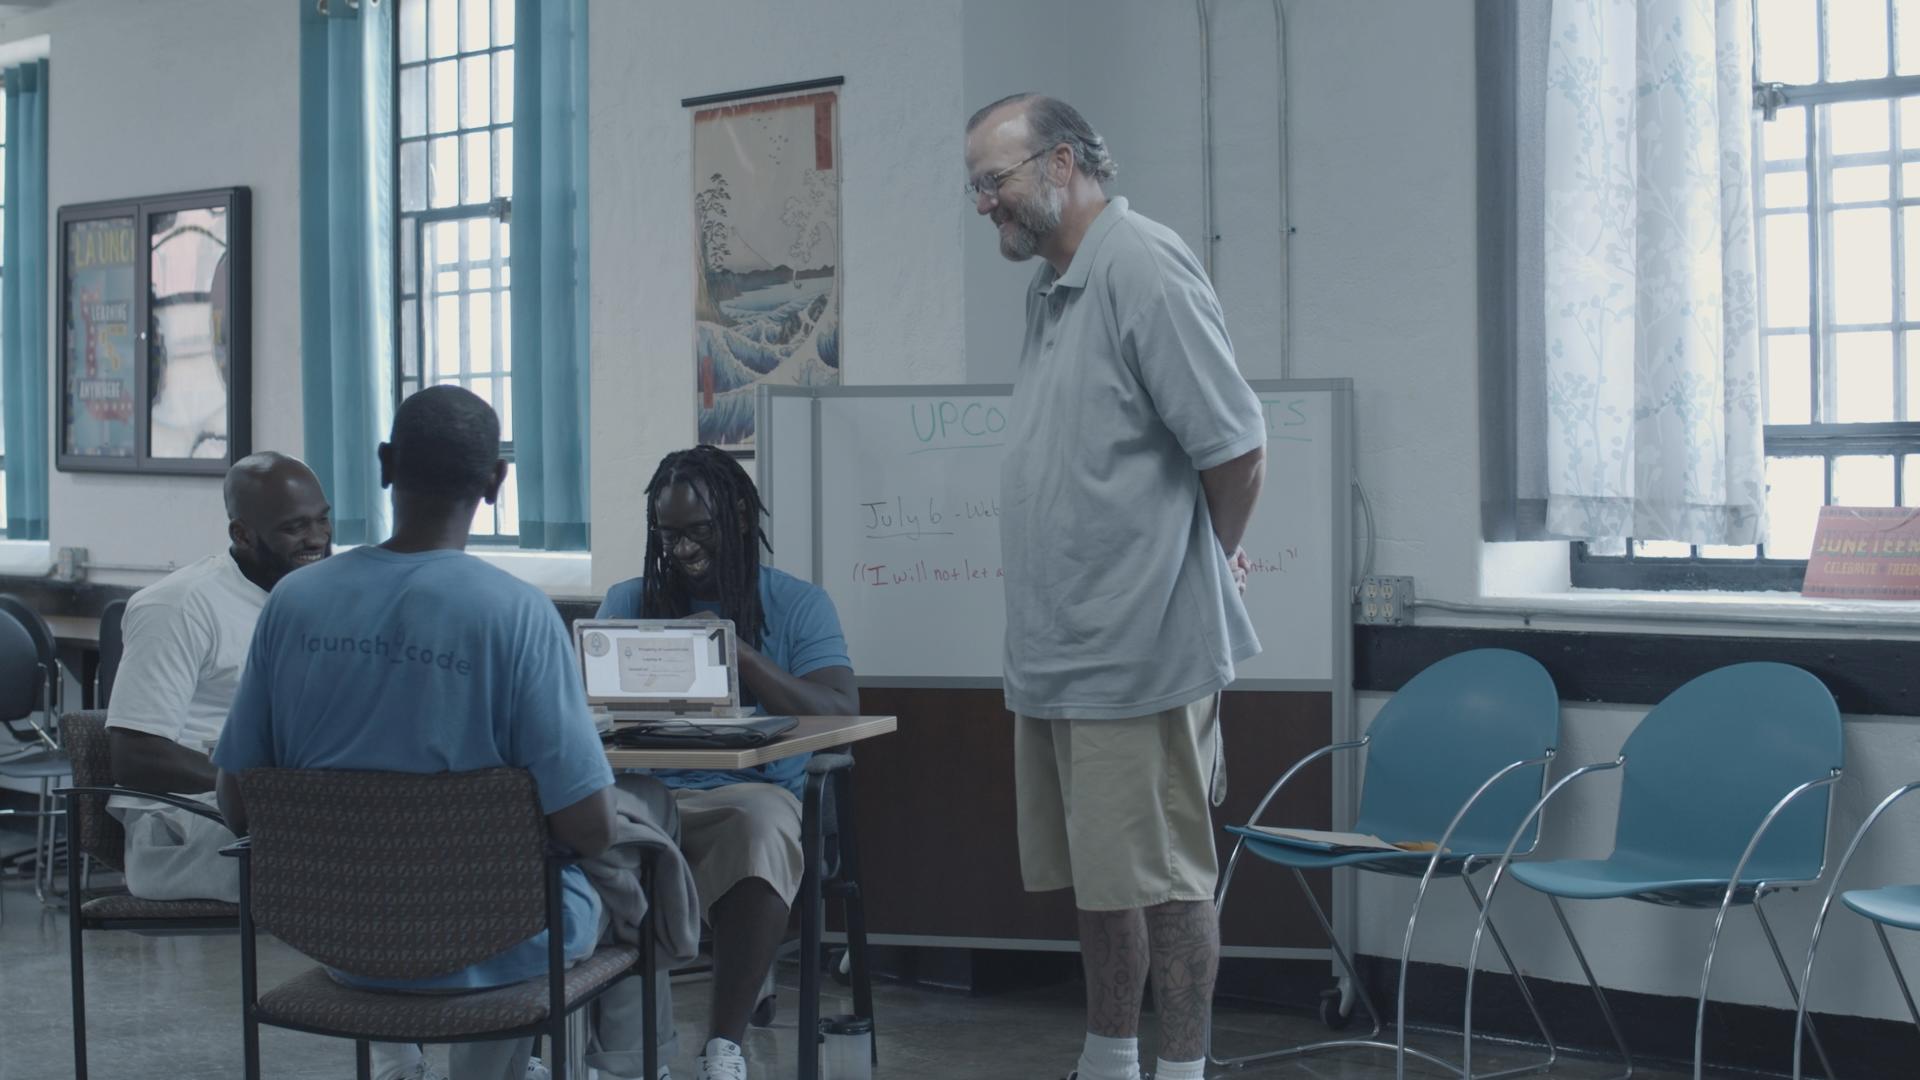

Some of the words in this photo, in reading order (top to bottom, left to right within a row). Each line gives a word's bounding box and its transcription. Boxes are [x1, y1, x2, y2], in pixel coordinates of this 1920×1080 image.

[911, 400, 1007, 442] UPCO
[1261, 399, 1306, 429] TS
[860, 496, 920, 540] July
[893, 560, 928, 585] will
[933, 567, 961, 581] not
[964, 559, 988, 581] let
[1887, 562, 1920, 576] FREED
[708, 628, 727, 666] 1
